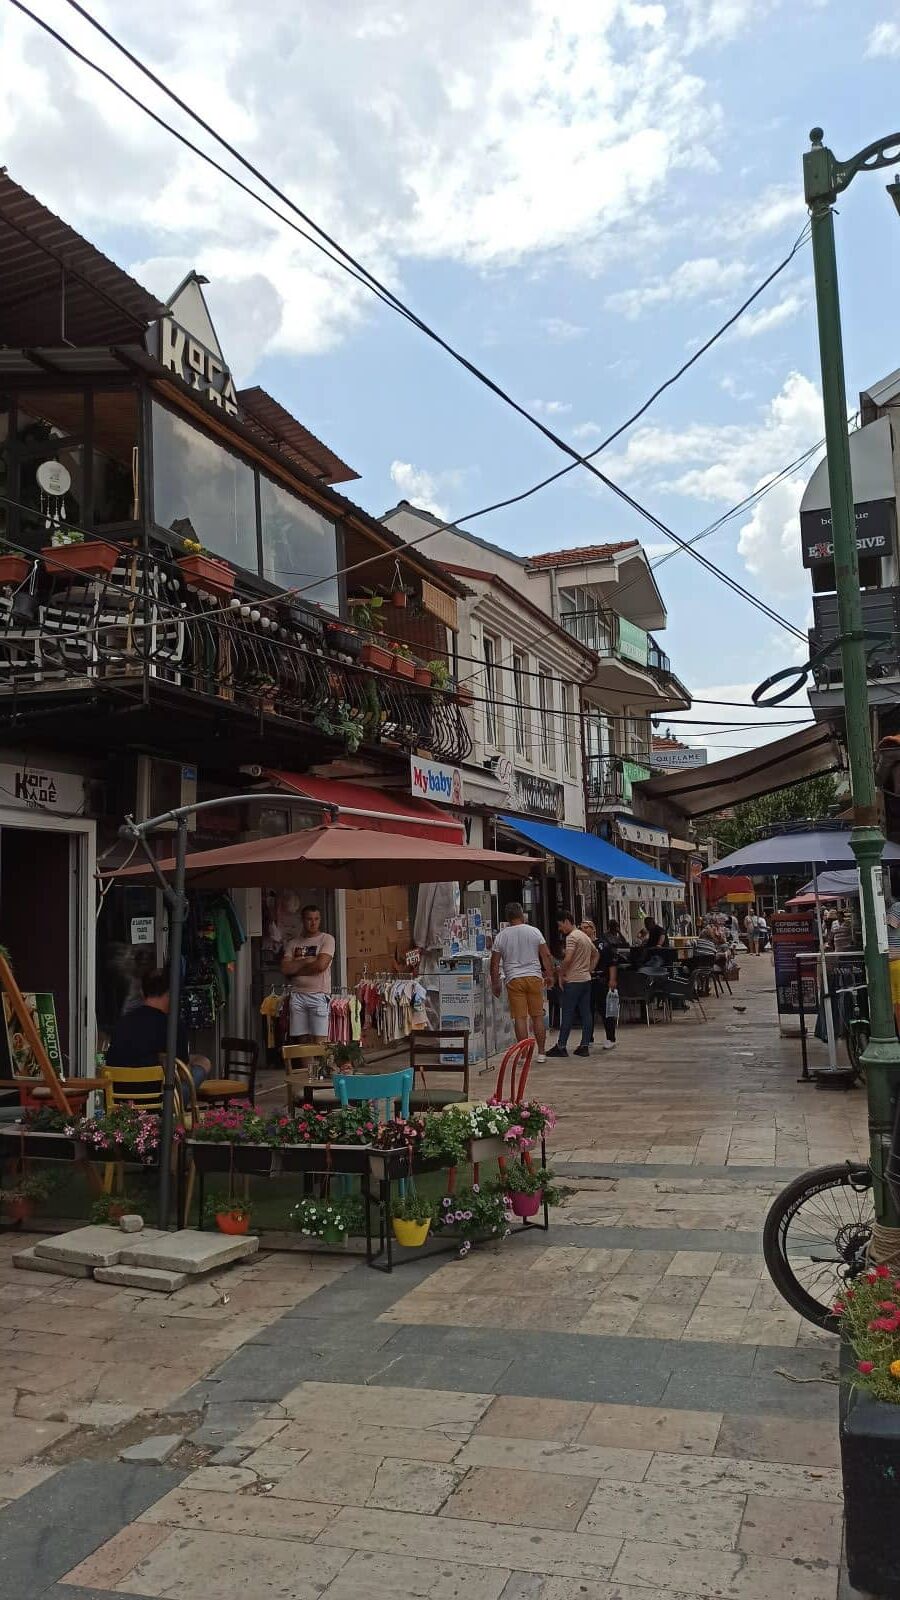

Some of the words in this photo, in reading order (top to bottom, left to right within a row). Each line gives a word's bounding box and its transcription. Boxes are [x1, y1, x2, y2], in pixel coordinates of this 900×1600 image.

[807, 535, 886, 558] EXCSIVE
[655, 753, 701, 762] ORIFLAME
[43, 1013, 59, 1060] BURRITO
